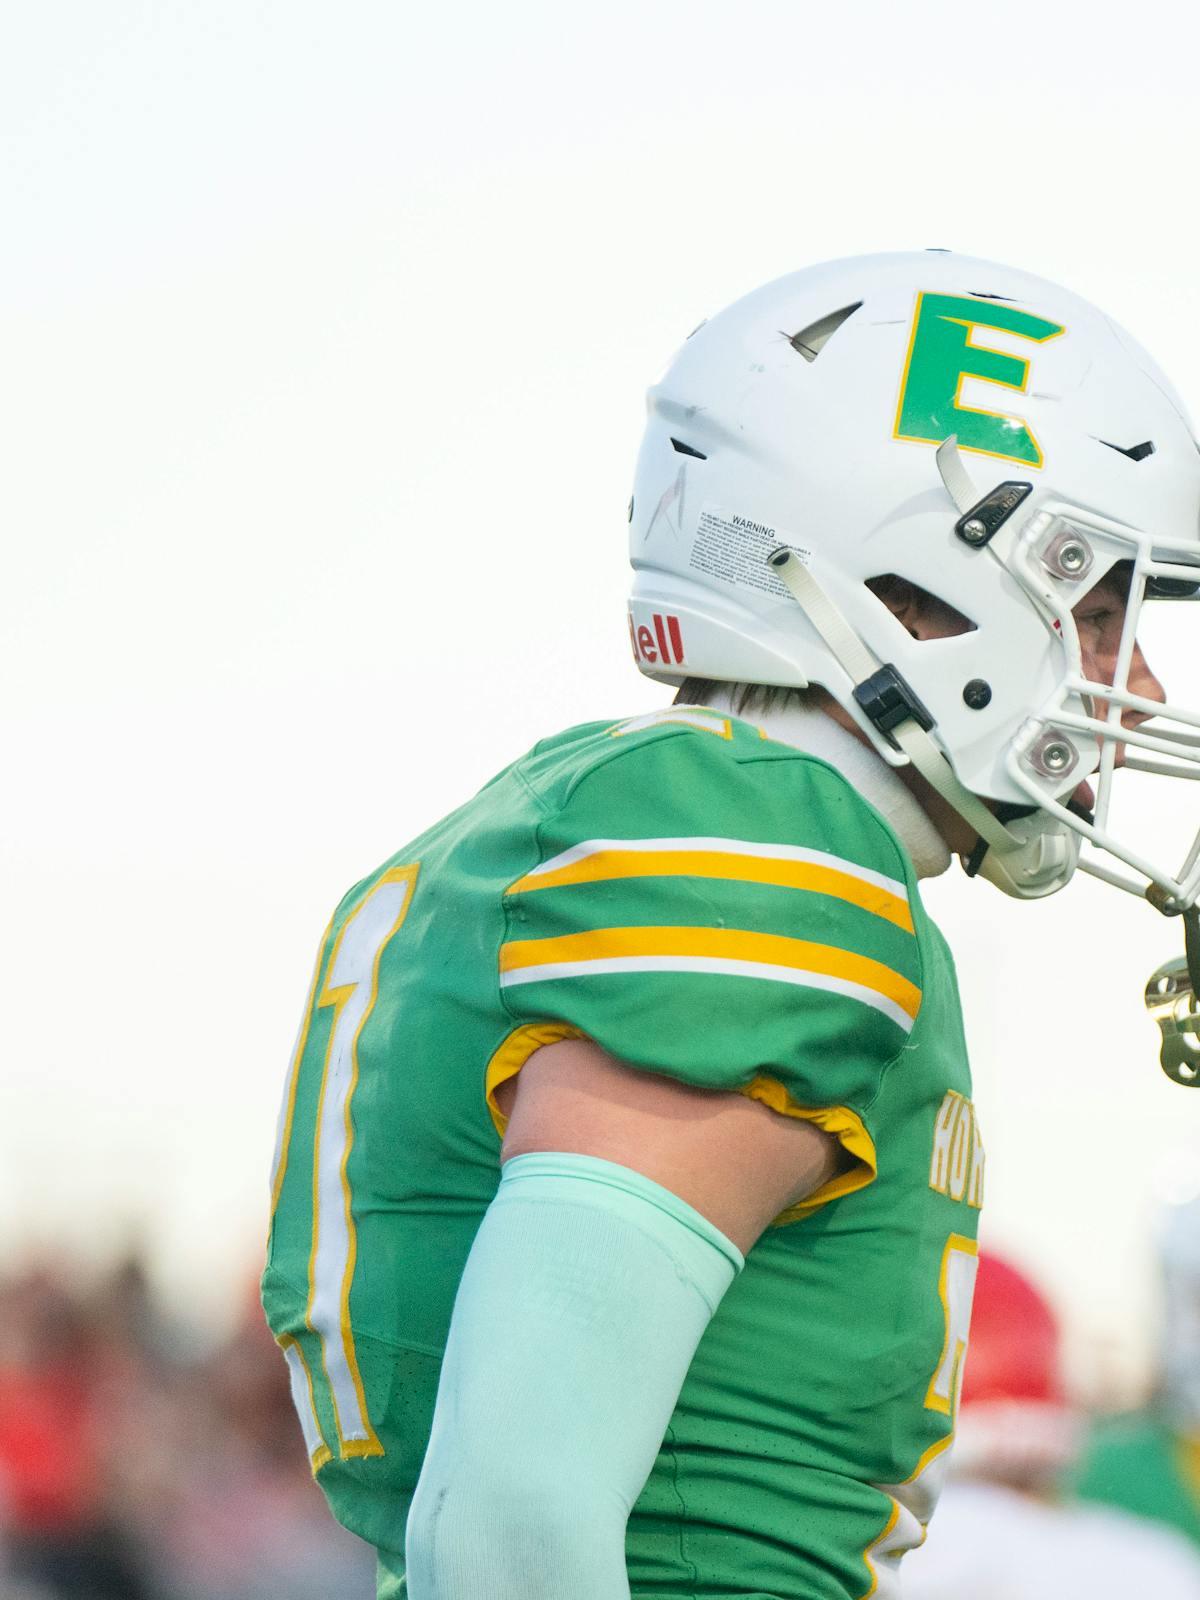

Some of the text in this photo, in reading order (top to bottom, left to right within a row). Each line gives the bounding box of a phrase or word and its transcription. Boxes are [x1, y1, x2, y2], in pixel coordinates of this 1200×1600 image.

[892, 290, 1066, 470] E
[732, 515, 775, 538] WARNING
[628, 613, 684, 664] ell
